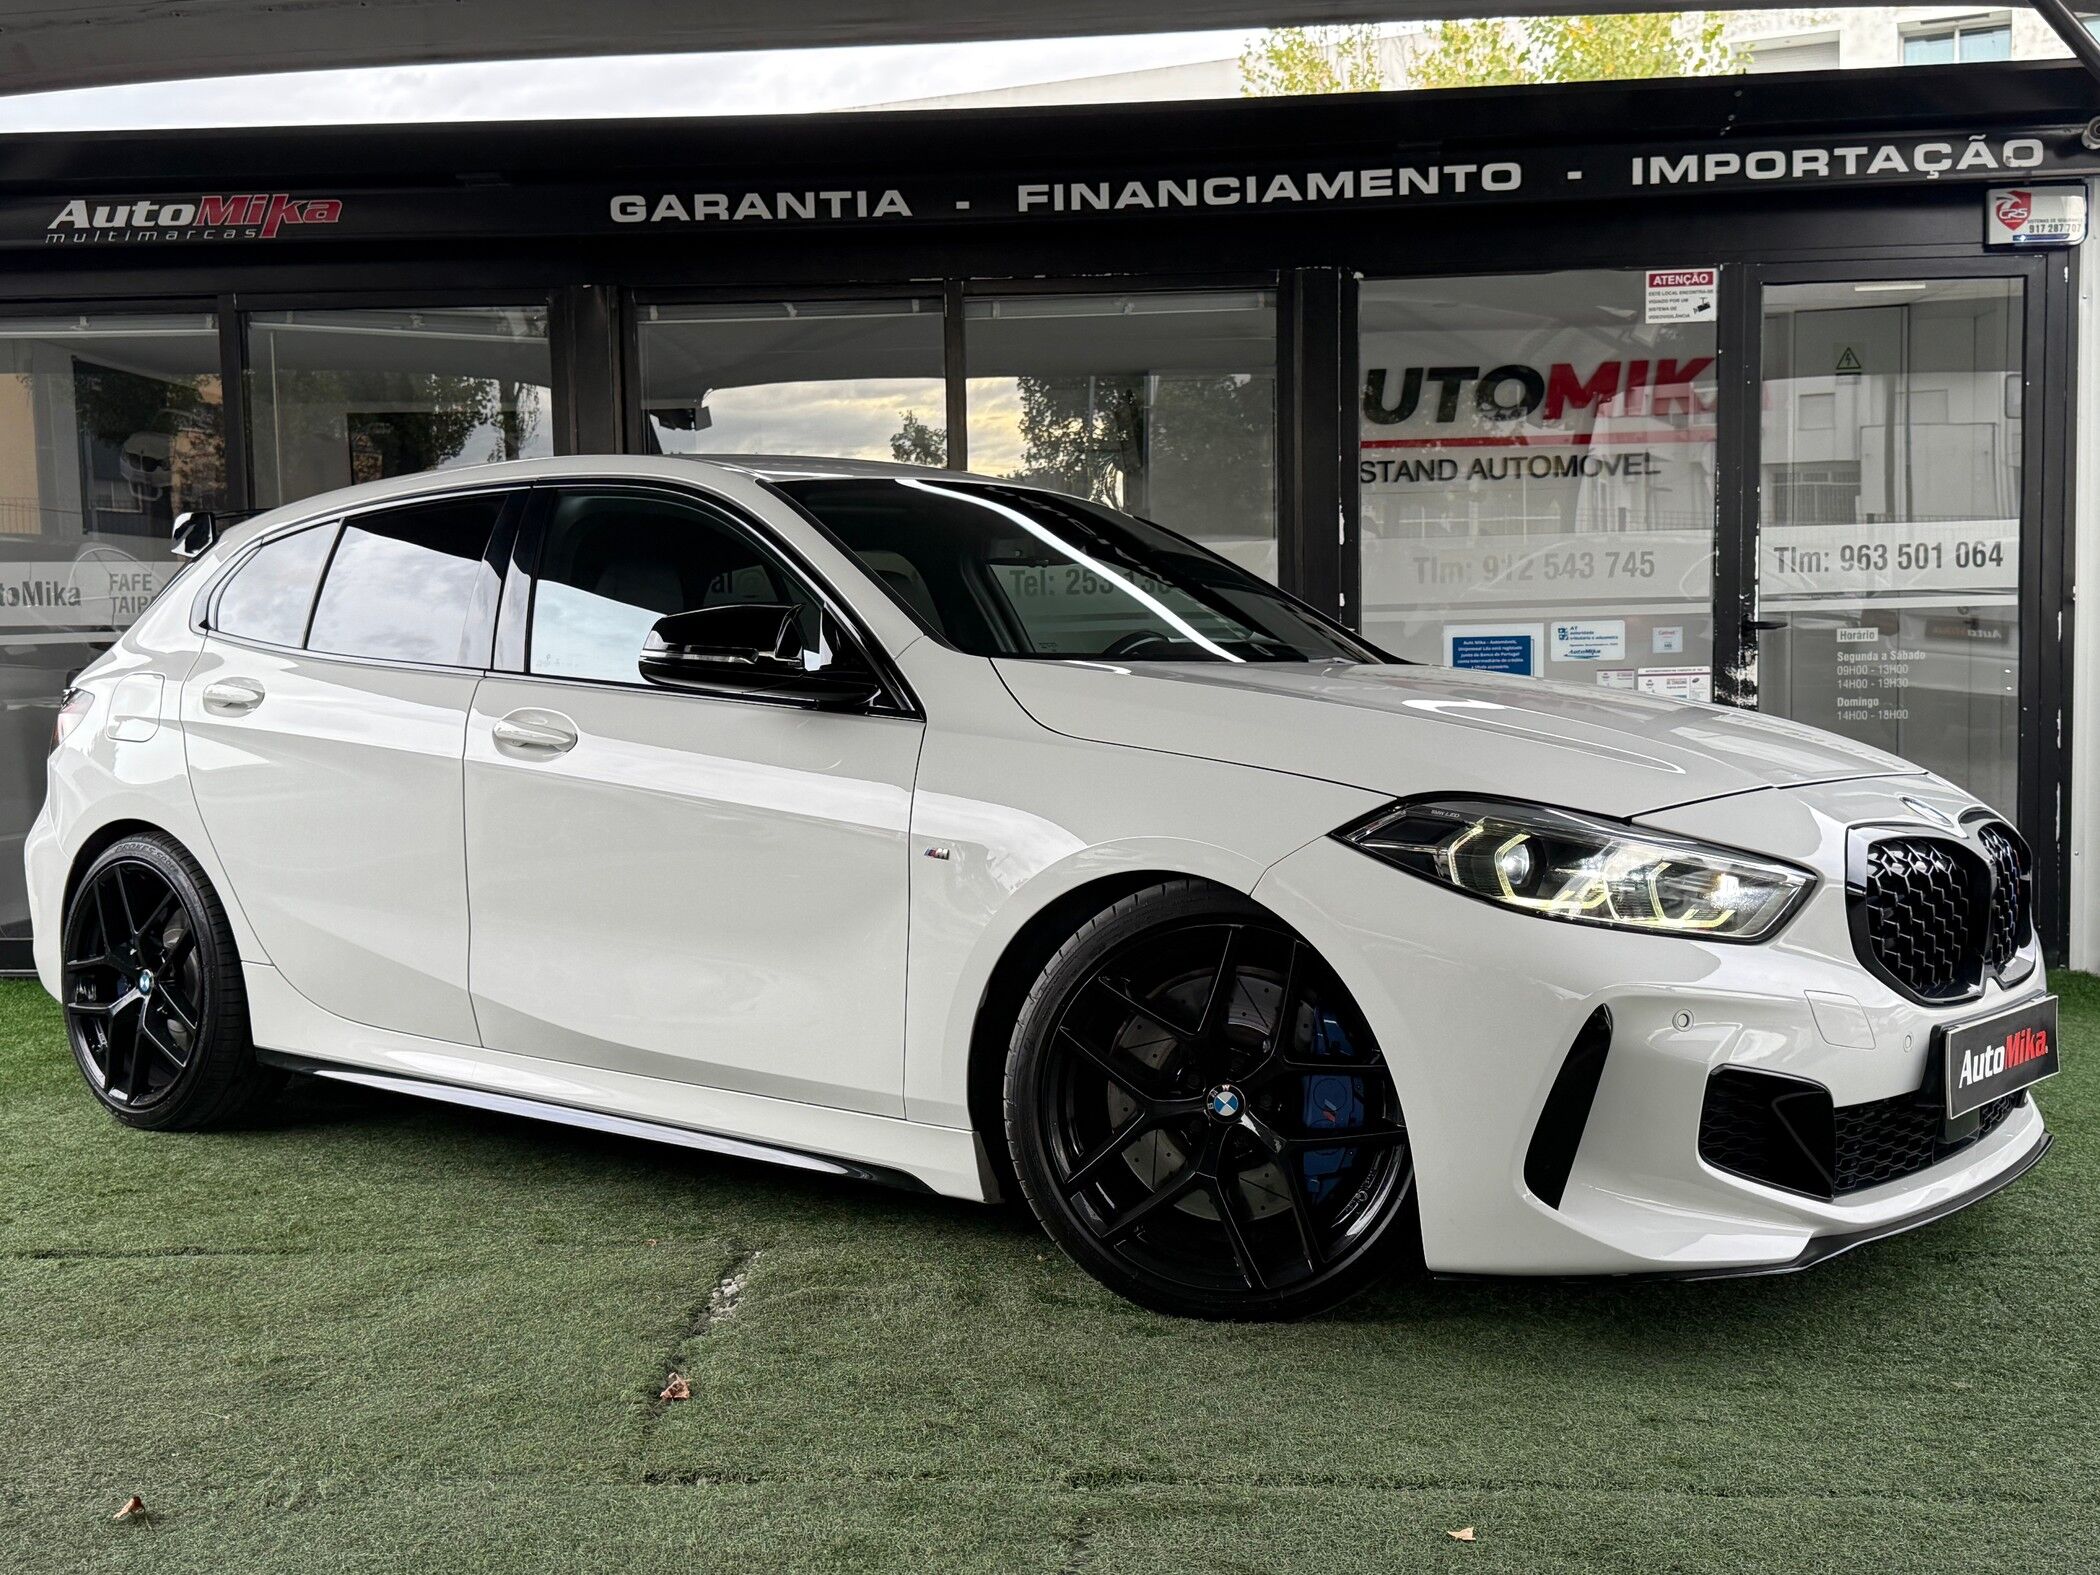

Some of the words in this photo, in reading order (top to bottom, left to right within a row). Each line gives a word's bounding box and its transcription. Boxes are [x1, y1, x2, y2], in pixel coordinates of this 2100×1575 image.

[610, 190, 913, 223] GARANTIA
[1017, 162, 1522, 212] FINANCIAMENTO
[1631, 134, 2045, 185] IMPORTAÇÃO
[47, 193, 343, 238] AutoMika
[1999, 208, 2028, 219] CRS
[45, 228, 256, 243] multimarcas
[2029, 224, 2045, 233] 917
[2047, 224, 2064, 232] 287
[1652, 272, 1709, 285] ATENÇÃO
[1360, 459, 1459, 484] STAND
[1773, 546, 1830, 573] Tlm:
[1839, 544, 1889, 571] 963
[1897, 542, 1943, 569] 501
[1954, 540, 2004, 568] 064
[1482, 553, 1534, 583] 912
[1543, 551, 1594, 580] 543
[1605, 549, 1656, 578] 745
[109, 573, 153, 592] FAFE
[1009, 568, 1057, 598] Tel:
[109, 595, 156, 614] TAIP
[1839, 629, 1875, 640] Horário
[1837, 651, 1879, 663] Segunda
[1881, 653, 1887, 661] a
[1890, 650, 1926, 661] Sábado
[1836, 665, 1868, 675] 09H00
[1878, 664, 1909, 674] 13H00
[1837, 679, 1868, 689] 14H00
[1878, 678, 1909, 688] 19H30
[1837, 697, 1880, 708] Domingo
[1837, 711, 1868, 720] 14H00
[1878, 709, 1909, 720] 18H00
[1207, 1084, 1231, 1110] BMW
